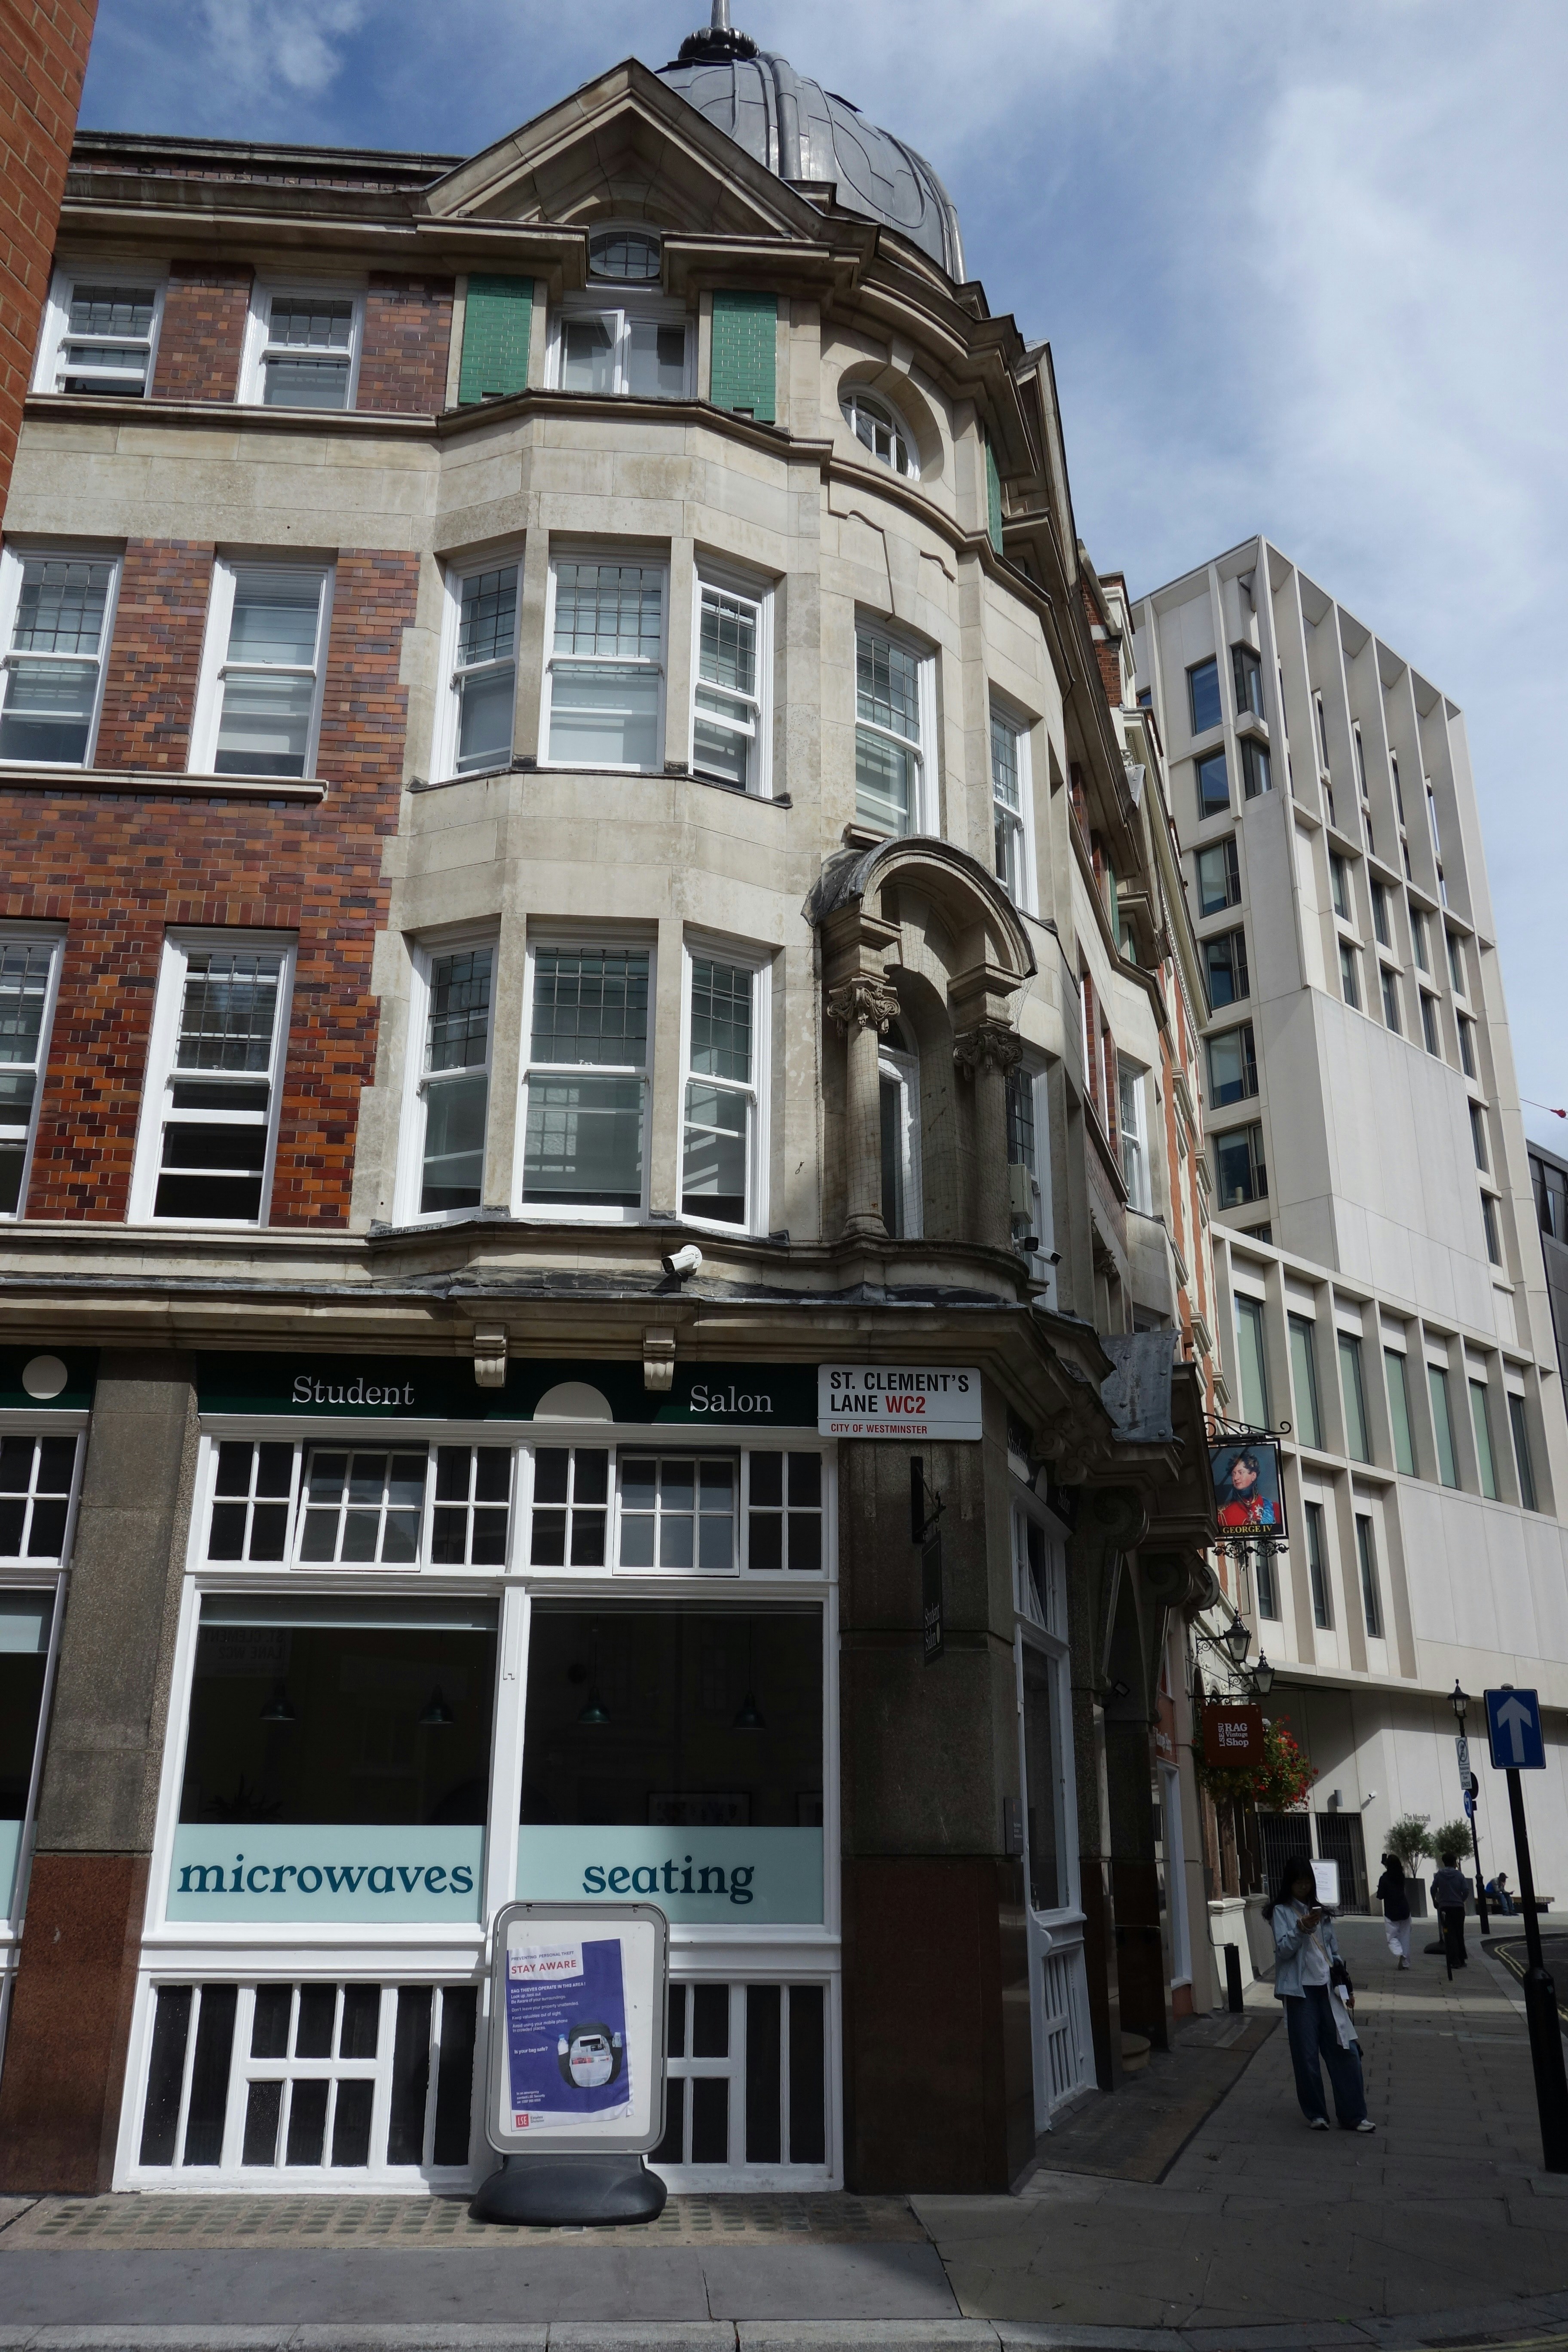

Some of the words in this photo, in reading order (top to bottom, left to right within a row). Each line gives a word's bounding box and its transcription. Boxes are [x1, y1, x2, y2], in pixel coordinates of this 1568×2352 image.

[292, 1376, 414, 1405] Student
[830, 1371, 856, 1390] ST.
[864, 1372, 969, 1393] CLEMENT'S
[690, 1385, 773, 1413] Salon
[830, 1394, 878, 1413] LANE
[885, 1395, 926, 1415] WC2
[830, 1423, 850, 1433] CITY
[852, 1424, 864, 1433] OF
[866, 1424, 928, 1434] WESTMINSTER
[1008, 1427, 1028, 1464] Student
[1222, 1525, 1261, 1534] GEORGE
[925, 1601, 940, 1628] Student
[925, 1628, 937, 1651] Salon
[1225, 1723, 1248, 1732] RAG
[1226, 1738, 1249, 1748] Shop
[1413, 1813, 1431, 1822] Marshall
[177, 1853, 474, 1894] microwaves
[582, 1855, 755, 1905] seating
[511, 1964, 536, 1974] STAY
[539, 1960, 577, 1971] AWARE
[518, 2116, 527, 2125] LSE
